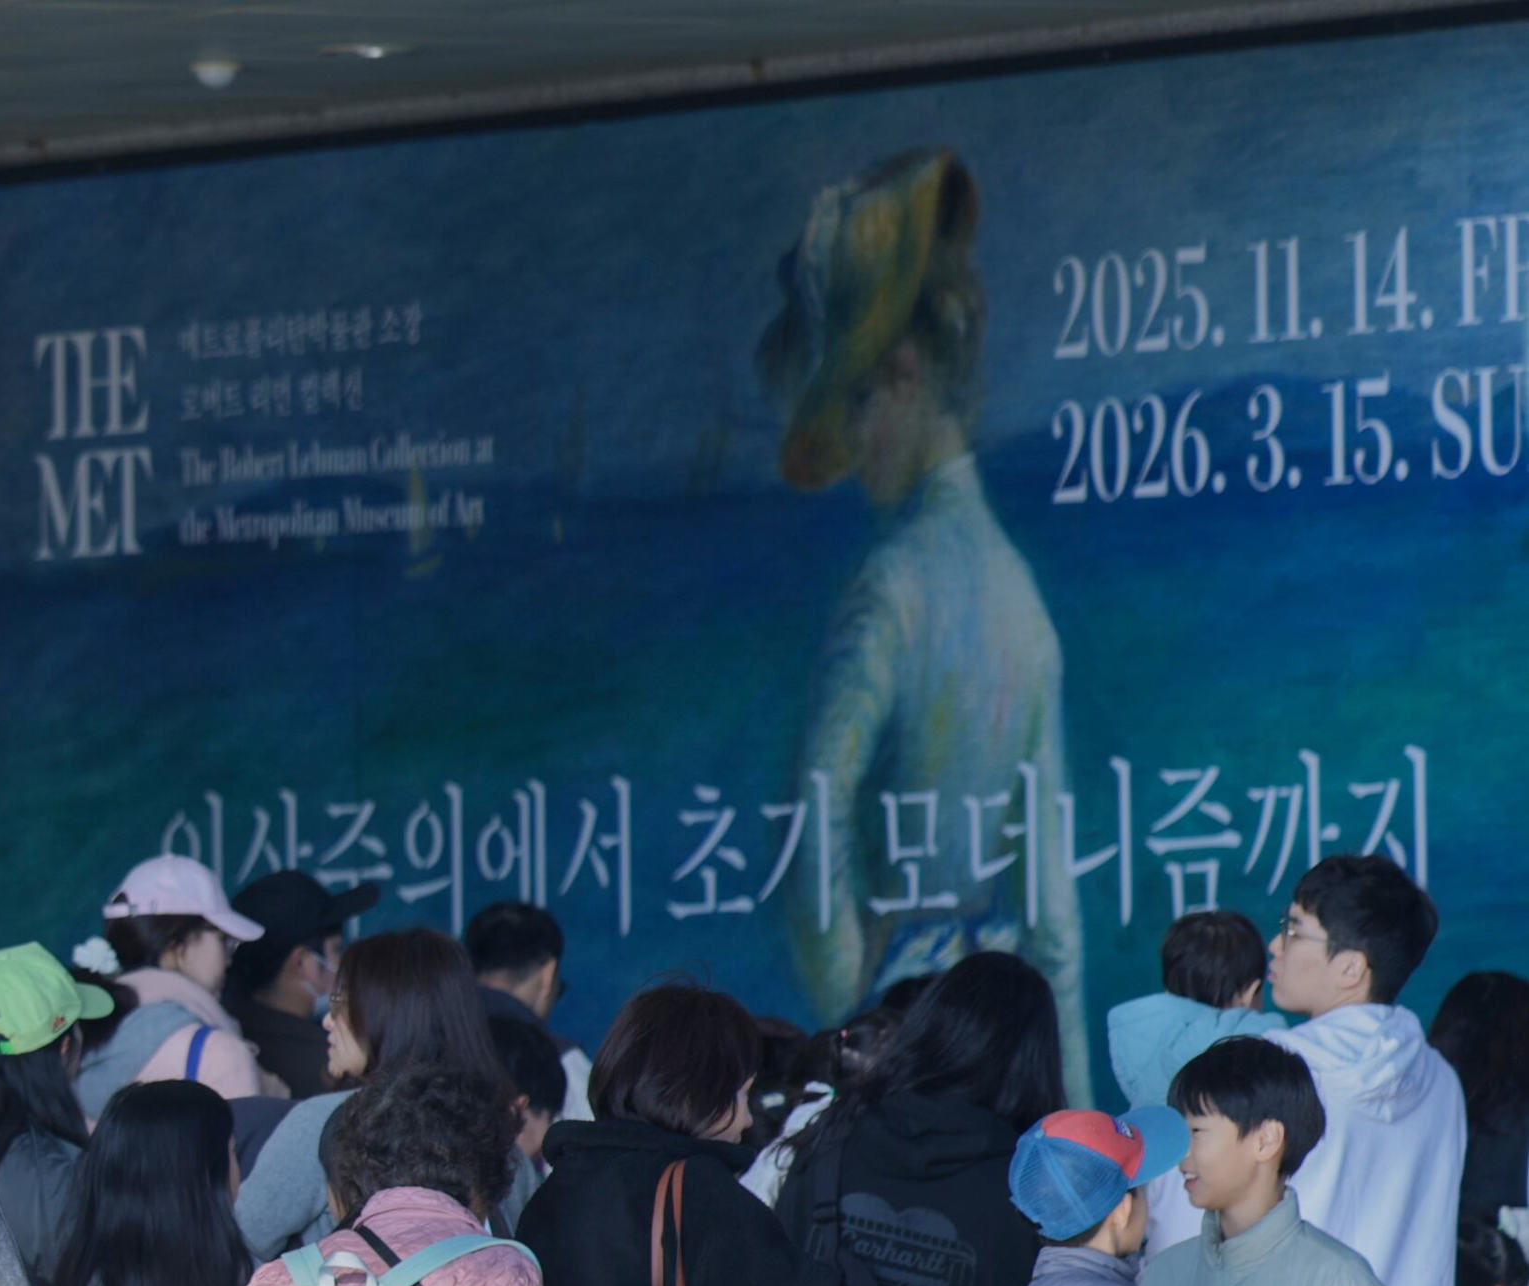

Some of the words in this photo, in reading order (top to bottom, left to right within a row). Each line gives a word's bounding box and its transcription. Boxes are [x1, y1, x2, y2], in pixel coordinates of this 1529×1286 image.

[1054, 241, 1225, 359] 2025.
[1247, 236, 1324, 343] 11.
[1345, 225, 1435, 336] 14.
[35, 325, 149, 440] THE
[1052, 388, 1227, 505] 2026.
[1246, 384, 1302, 492] 3.
[1322, 371, 1409, 486] 15.
[34, 446, 152, 561] MET
[178, 446, 215, 487] The
[219, 441, 285, 483] Robert
[288, 437, 367, 478] Lehman
[370, 431, 471, 471] Collection
[474, 435, 494, 465] at
[178, 506, 212, 545] the
[215, 500, 338, 551] Metropolitan
[342, 495, 424, 533] Museum
[454, 489, 485, 526] Art
[666, 767, 831, 935] 초기
[869, 743, 1429, 929] 모더니즘까지
